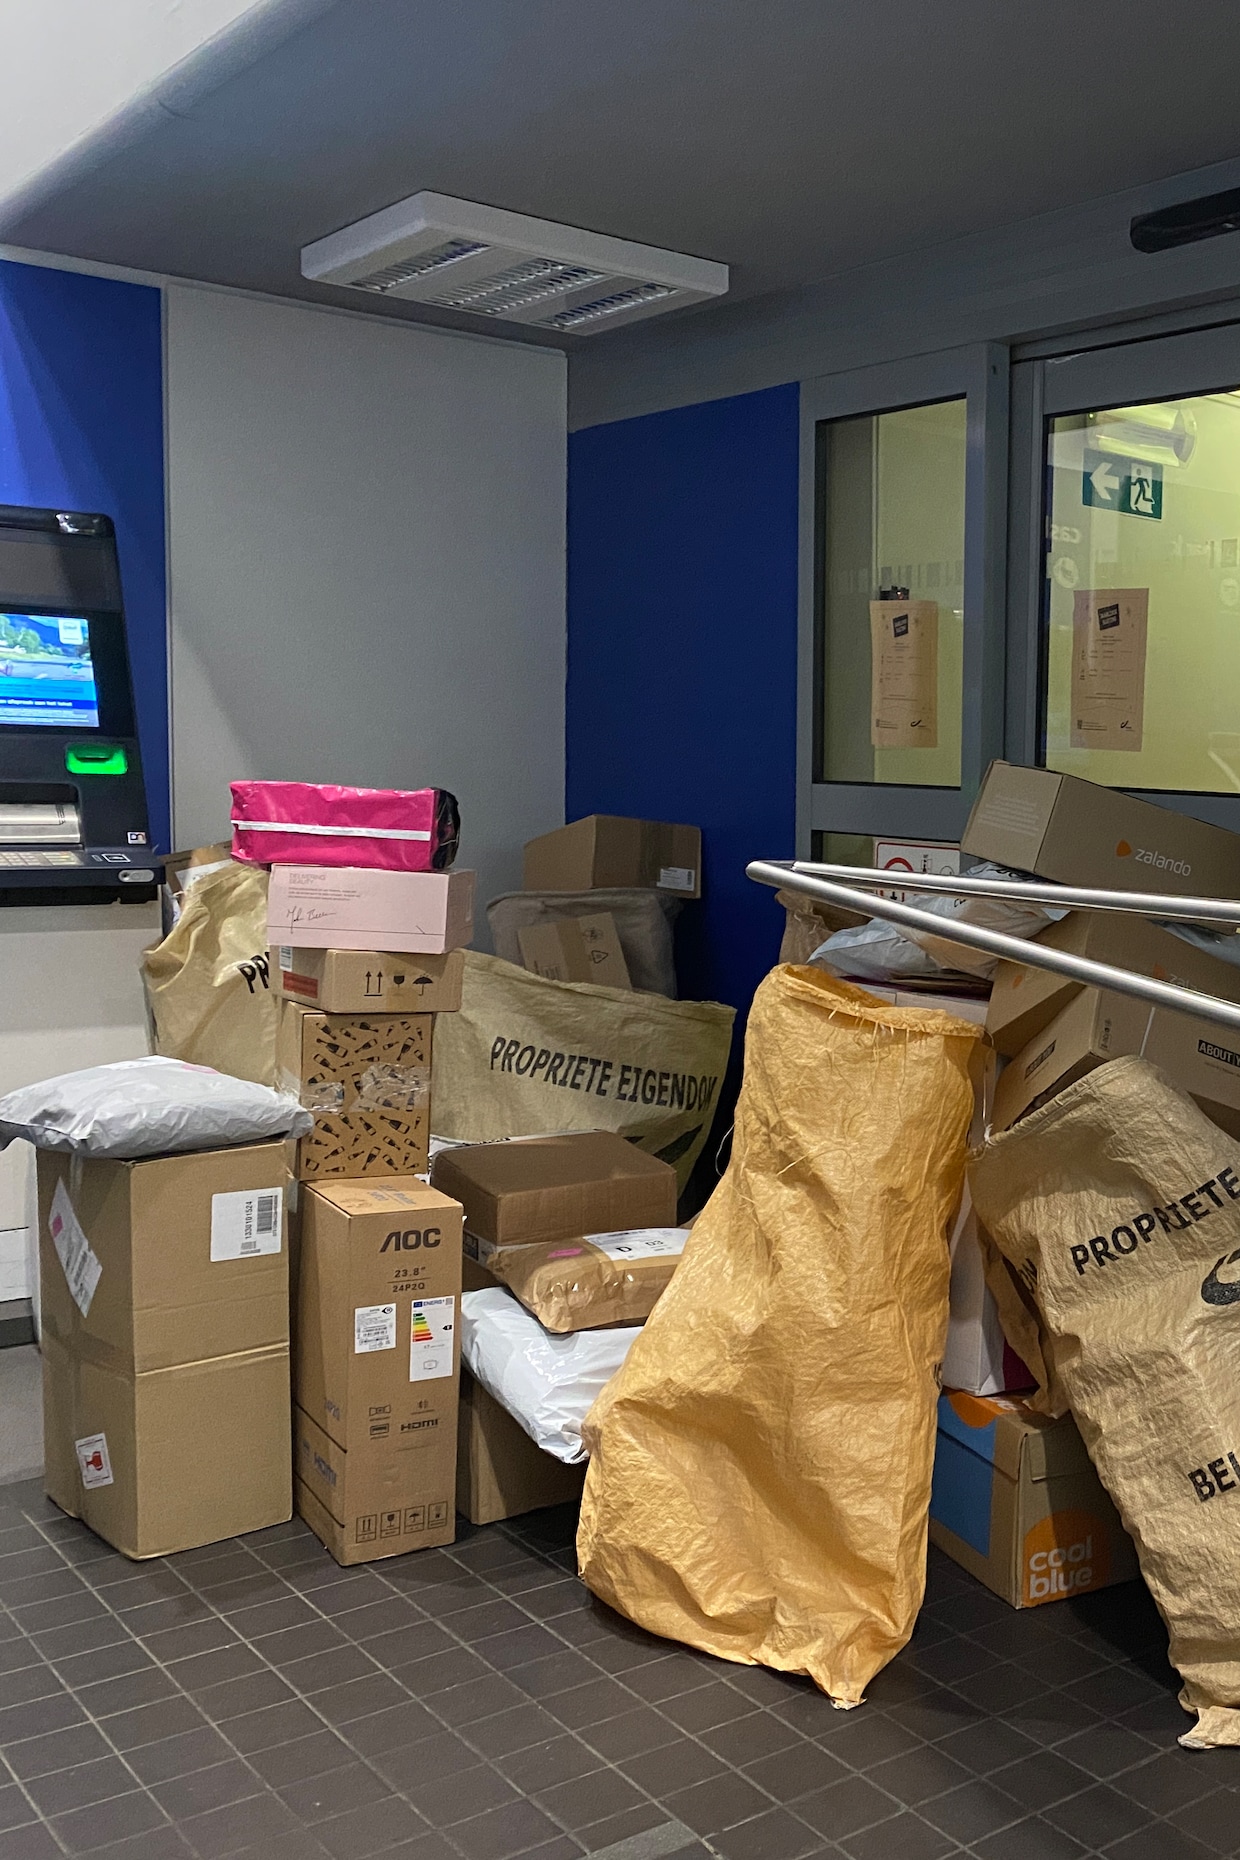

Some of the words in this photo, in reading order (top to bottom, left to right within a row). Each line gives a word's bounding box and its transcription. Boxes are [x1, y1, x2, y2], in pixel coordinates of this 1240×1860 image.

[1135, 848, 1192, 877] zalando
[237, 951, 270, 994] PR
[490, 1036, 613, 1097] PROPRIETE
[1199, 1042, 1233, 1064] ABOUT
[379, 1227, 442, 1254] AOC
[392, 1281, 426, 1293] 24P2Q
[400, 1418, 439, 1432] HDMI
[1028, 1534, 1093, 1572] cool
[1029, 1566, 1093, 1599] blue
